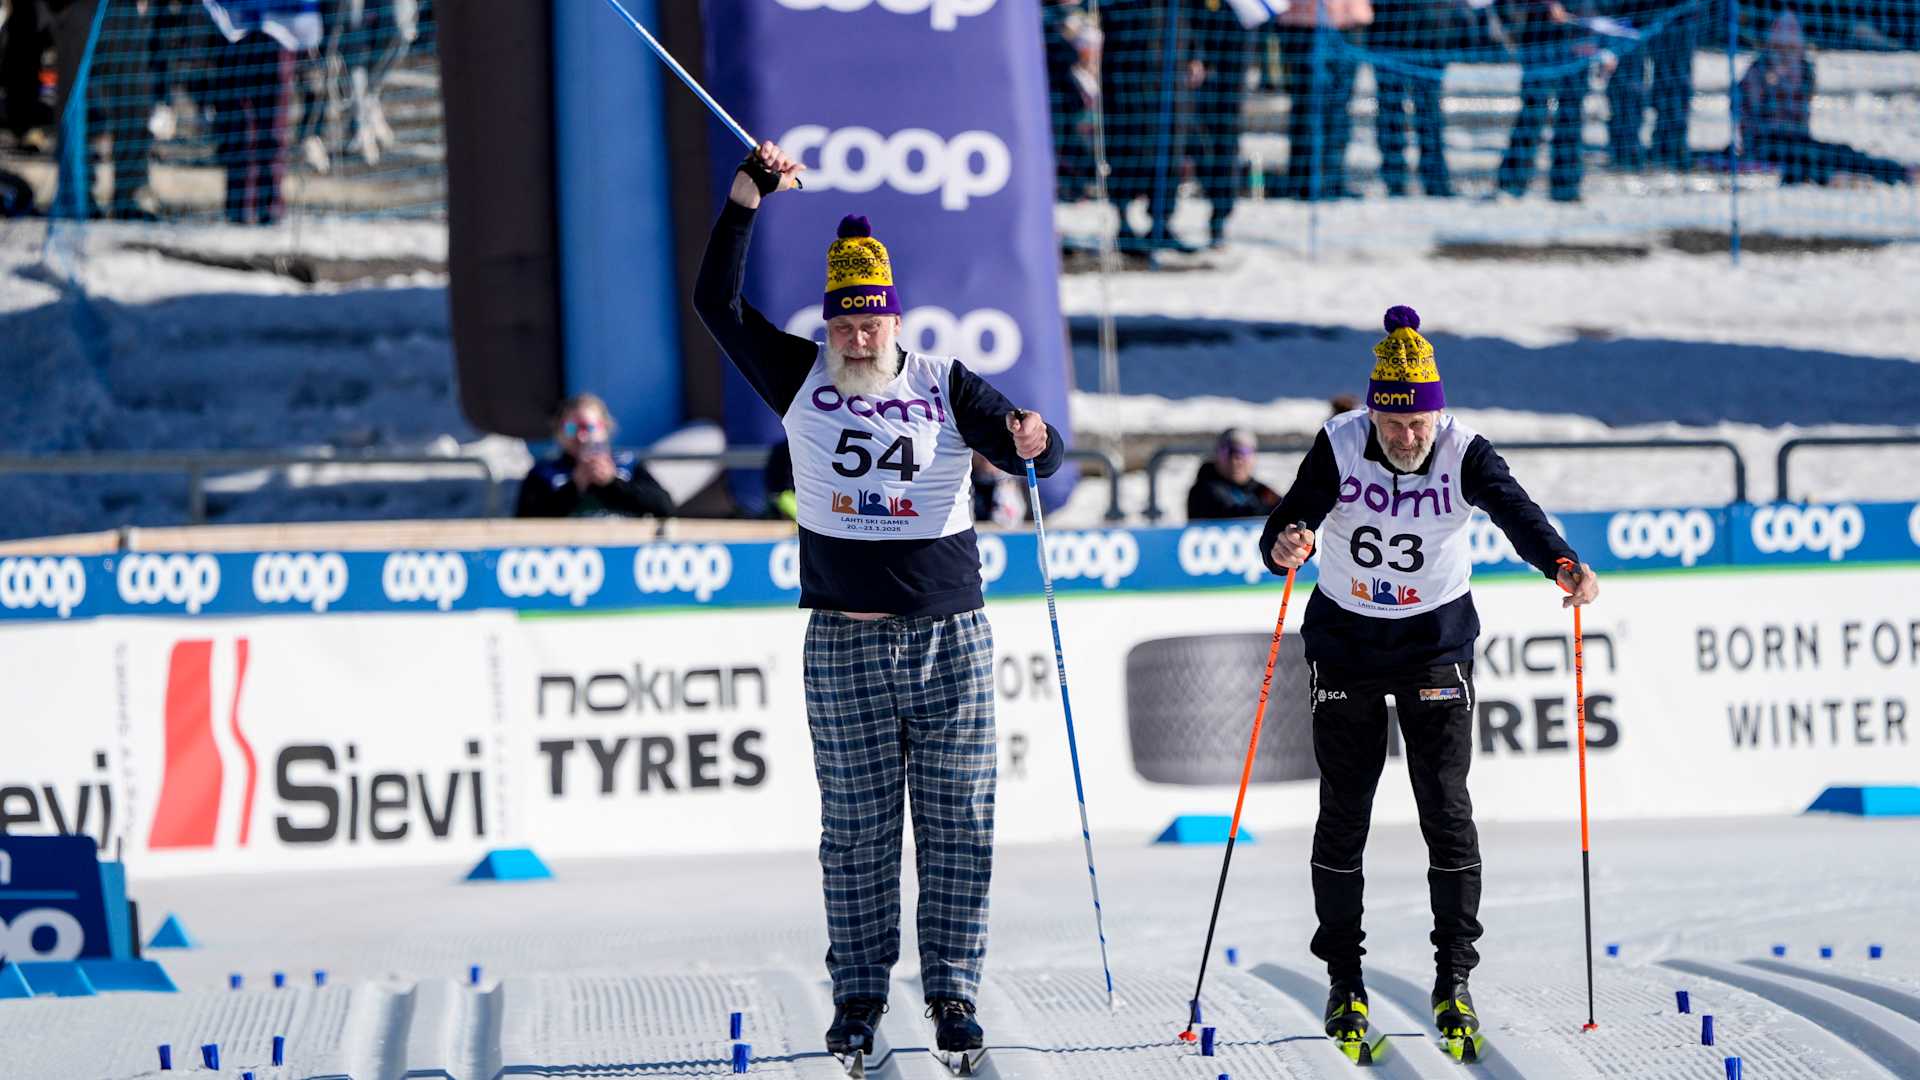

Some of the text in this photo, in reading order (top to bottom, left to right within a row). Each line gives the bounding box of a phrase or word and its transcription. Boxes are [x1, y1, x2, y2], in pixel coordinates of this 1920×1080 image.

[777, 123, 1012, 211] coop
[840, 290, 888, 310] oomi
[782, 304, 1023, 375] cop
[811, 384, 946, 423] oomi
[1373, 388, 1416, 406] oomi
[831, 428, 920, 482] 54
[840, 516, 863, 524] LAHTI
[1339, 473, 1452, 518] oomi
[1037, 530, 1140, 588] coop
[1350, 525, 1425, 573] 63
[1607, 509, 1715, 567] coop
[1751, 502, 1865, 561] coop
[0, 555, 86, 617] coop
[117, 552, 220, 614] coop
[252, 552, 349, 612] coop
[382, 551, 468, 610] coop
[497, 547, 605, 607] coop
[633, 543, 732, 603] coop
[1475, 633, 1616, 679] kian
[1697, 624, 1819, 672] BORN
[536, 657, 768, 717] nokian
[997, 654, 1053, 702] OR
[1327, 691, 1348, 700] SCA
[1478, 693, 1620, 754] RES
[1728, 698, 1908, 748] WINTER
[538, 727, 768, 797] TYRES
[274, 738, 486, 846] Sievi
